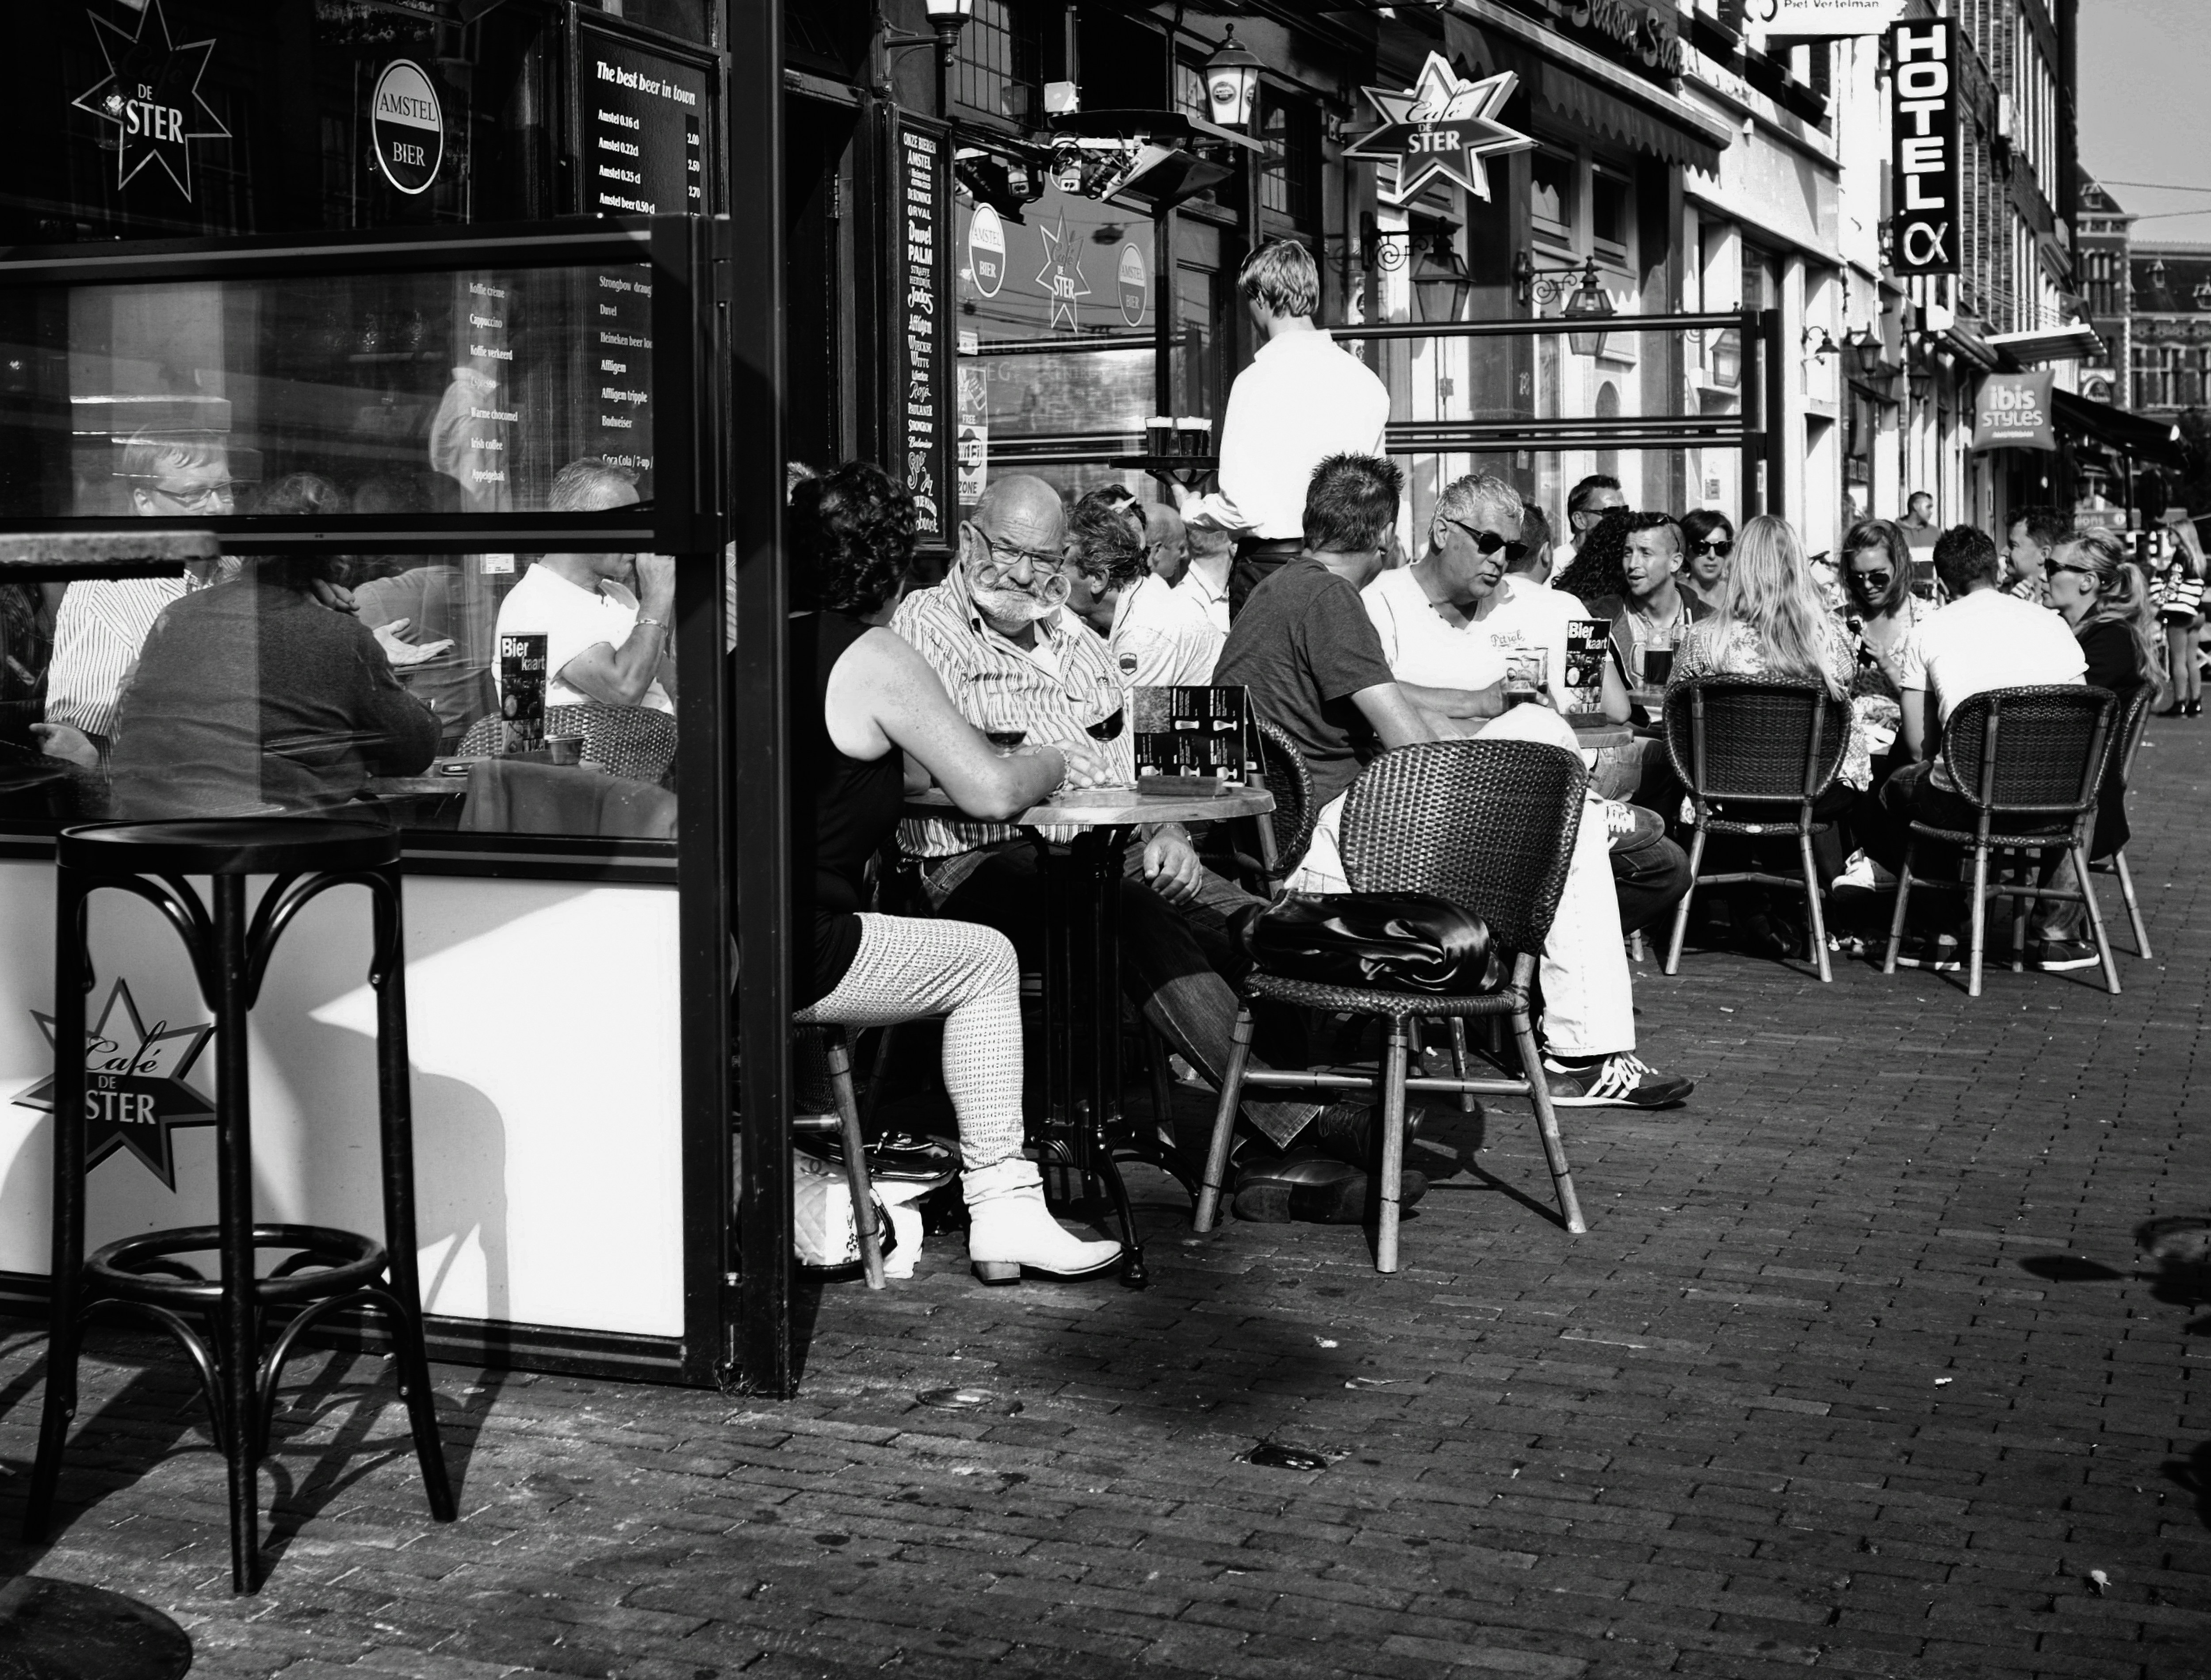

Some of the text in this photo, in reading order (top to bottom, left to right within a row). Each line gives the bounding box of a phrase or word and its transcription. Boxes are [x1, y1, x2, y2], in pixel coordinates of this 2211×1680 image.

[597, 61, 696, 105] The best beer in town
[138, 83, 153, 101] DE
[379, 92, 436, 122] AMSTEL
[126, 99, 184, 144] STER
[598, 109, 619, 125] Amstel
[620, 115, 633, 128] 0.16
[1897, 24, 1949, 210] HOTEL
[1418, 123, 1432, 132] DE
[598, 137, 620, 152] Amstel
[687, 133, 700, 146] 2.00
[903, 133, 918, 149] ONZE
[1408, 130, 1461, 153] STER
[392, 141, 425, 167] BIER
[907, 149, 932, 170] AMSTEL
[599, 164, 620, 179] Amstel
[621, 170, 634, 183] 0.25
[688, 185, 701, 199] 2.70
[599, 192, 620, 207] Amstel
[622, 197, 635, 210] beer
[635, 200, 649, 213] 0.50
[908, 204, 932, 220] ORVAL
[908, 219, 932, 245] Duvel
[973, 228, 1001, 247] AMSTEL
[908, 244, 932, 265] PALM
[979, 261, 997, 278] BIER
[1121, 265, 1144, 281] AMSTEL
[470, 283, 486, 295] Koffie
[599, 275, 631, 292] Strongbow
[1054, 275, 1075, 299] STER
[600, 304, 617, 316] Duvel
[470, 313, 502, 328] Cappuccino
[600, 332, 628, 346] Heineken
[629, 336, 643, 348] beer
[471, 344, 513, 361] Koffie verkeerd
[601, 359, 626, 375] Affligem
[601, 387, 627, 402] Affligem
[909, 381, 932, 403] Rosé
[1990, 384, 2035, 410] ibis
[471, 407, 490, 419] Warme
[963, 414, 975, 424] FREE
[471, 437, 503, 451] Irish coffee
[619, 454, 631, 467] Cola
[959, 481, 978, 494] ZONE
[1568, 622, 1595, 638] Bier
[502, 638, 528, 657] Bier
[1585, 637, 1607, 649] kaart
[522, 655, 544, 671] kaart
[86, 1020, 166, 1090] Café
[98, 1076, 116, 1089] DE
[86, 1090, 156, 1120] STER
